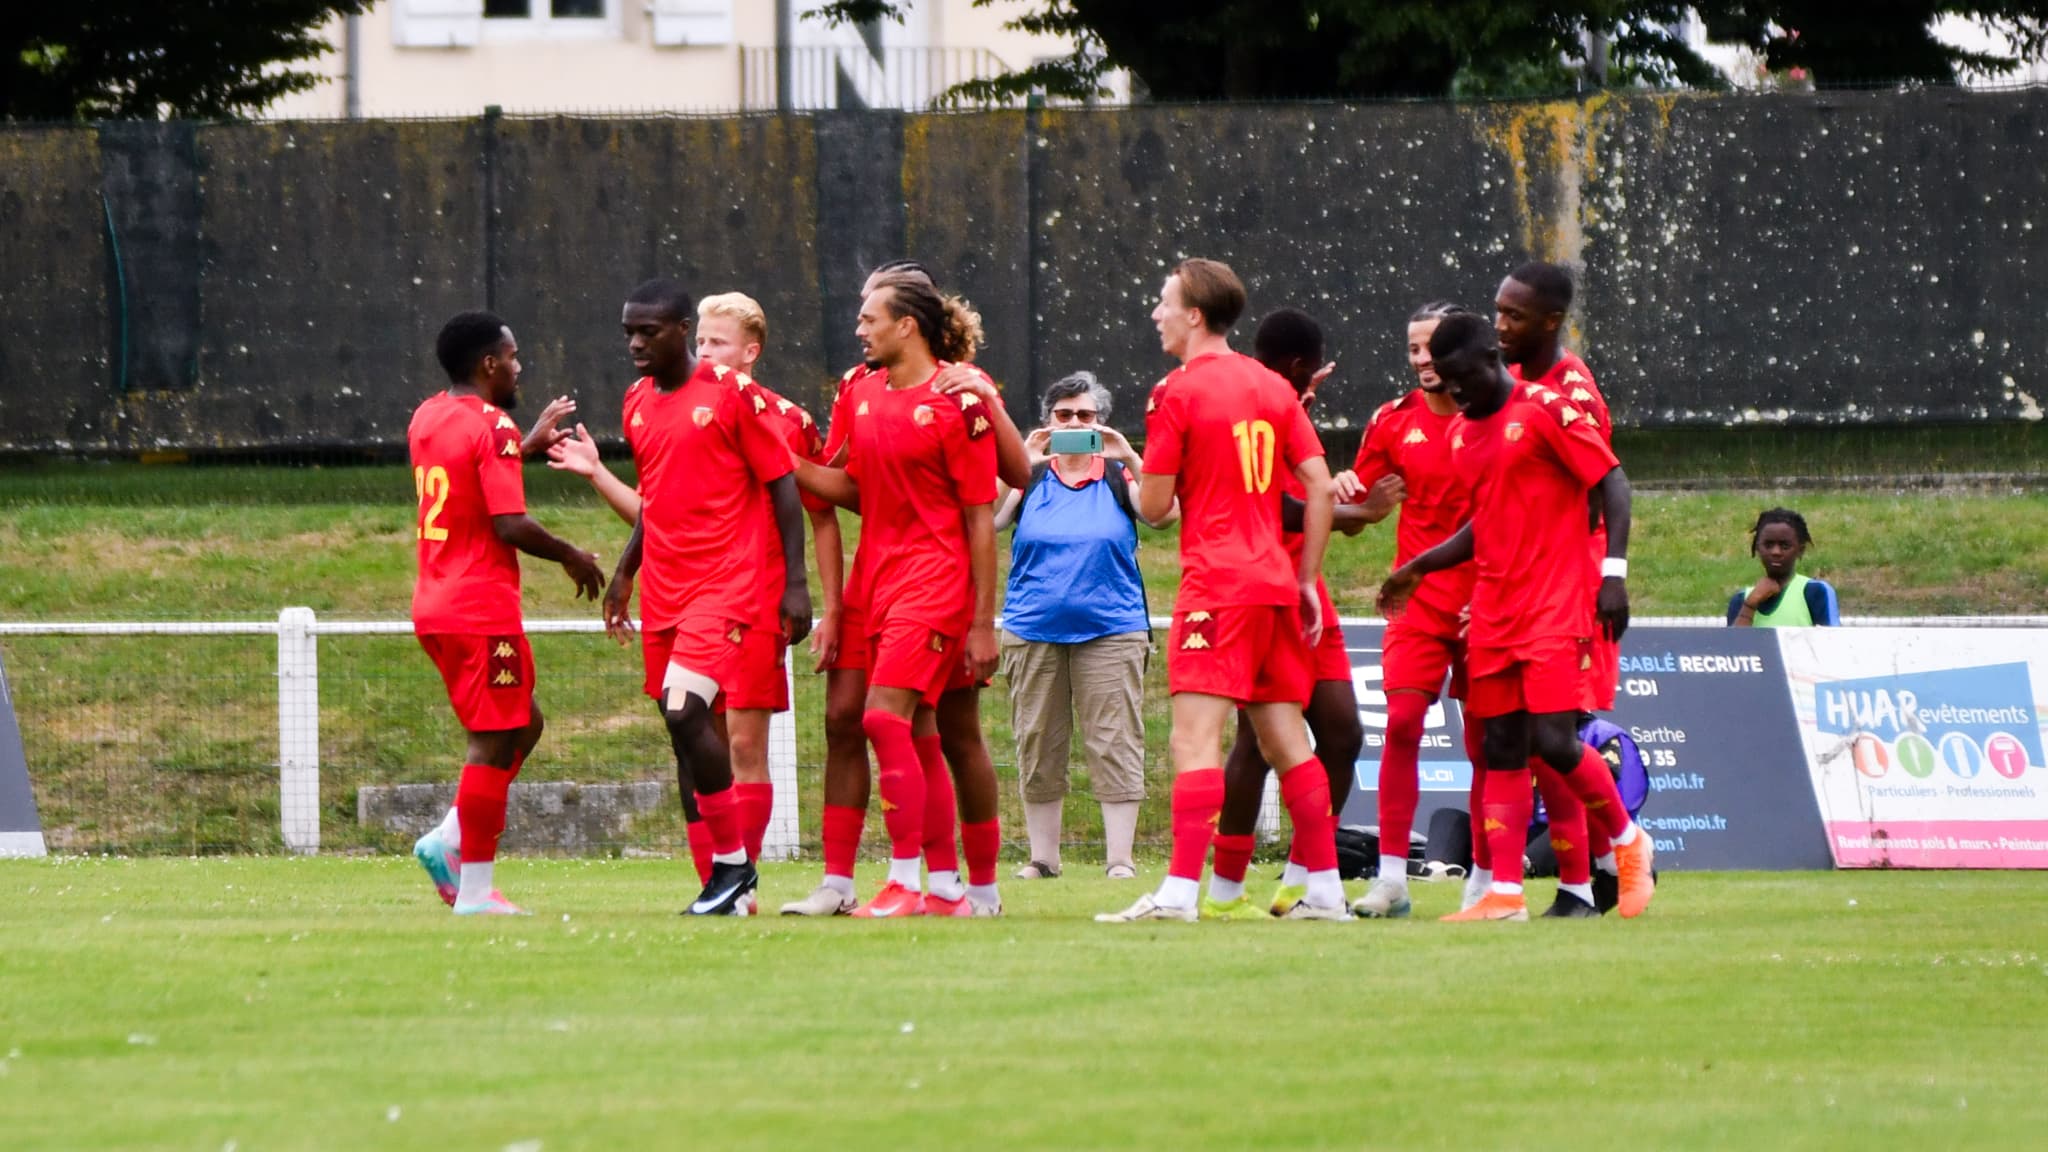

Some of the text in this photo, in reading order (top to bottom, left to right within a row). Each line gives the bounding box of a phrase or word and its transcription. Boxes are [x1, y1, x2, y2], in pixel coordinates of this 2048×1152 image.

[1232, 419, 1275, 494] 10
[414, 465, 449, 541] 22
[1618, 652, 1763, 673] SABLÉ RECRUTE
[1626, 679, 1659, 696] CDI
[1630, 726, 1687, 743] Sarthe
[1653, 750, 1677, 767] 35
[1868, 784, 1938, 799] Particuliers
[1947, 784, 2036, 799] Professionnels
